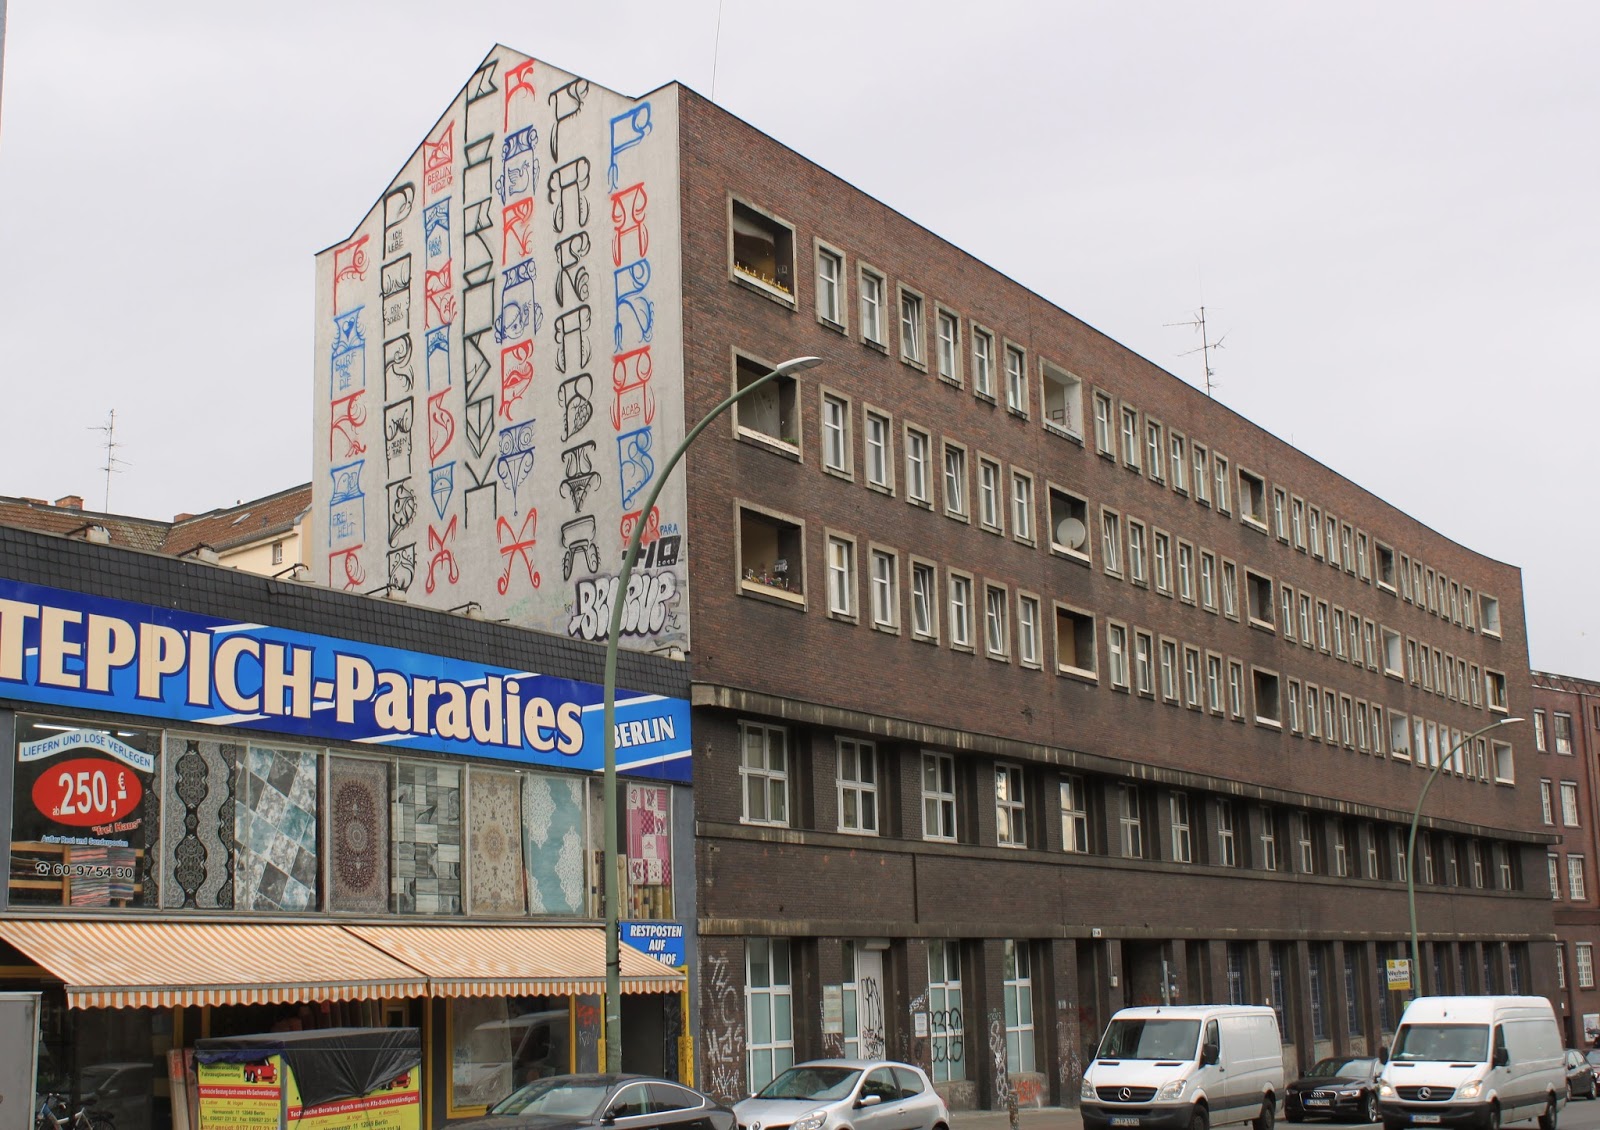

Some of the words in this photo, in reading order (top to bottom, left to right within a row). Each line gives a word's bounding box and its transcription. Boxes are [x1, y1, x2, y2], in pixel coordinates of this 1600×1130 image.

[23, 738, 60, 757] LIEFERN
[63, 733, 81, 746] UND
[84, 733, 105, 746] LOSE
[107, 739, 151, 768] VERLEGEN
[52, 806, 60, 816] ab
[76, 837, 87, 845] und
[53, 864, 71, 876] 60
[116, 867, 134, 879] 30
[630, 925, 683, 938] RESTPOSTEN
[649, 939, 666, 951] AUF
[660, 953, 677, 966] HOF
[290, 1108, 318, 1117] Techische
[318, 1106, 340, 1114] Beratung
[340, 1103, 354, 1111] durch
[375, 1118, 389, 1127] Berlin
